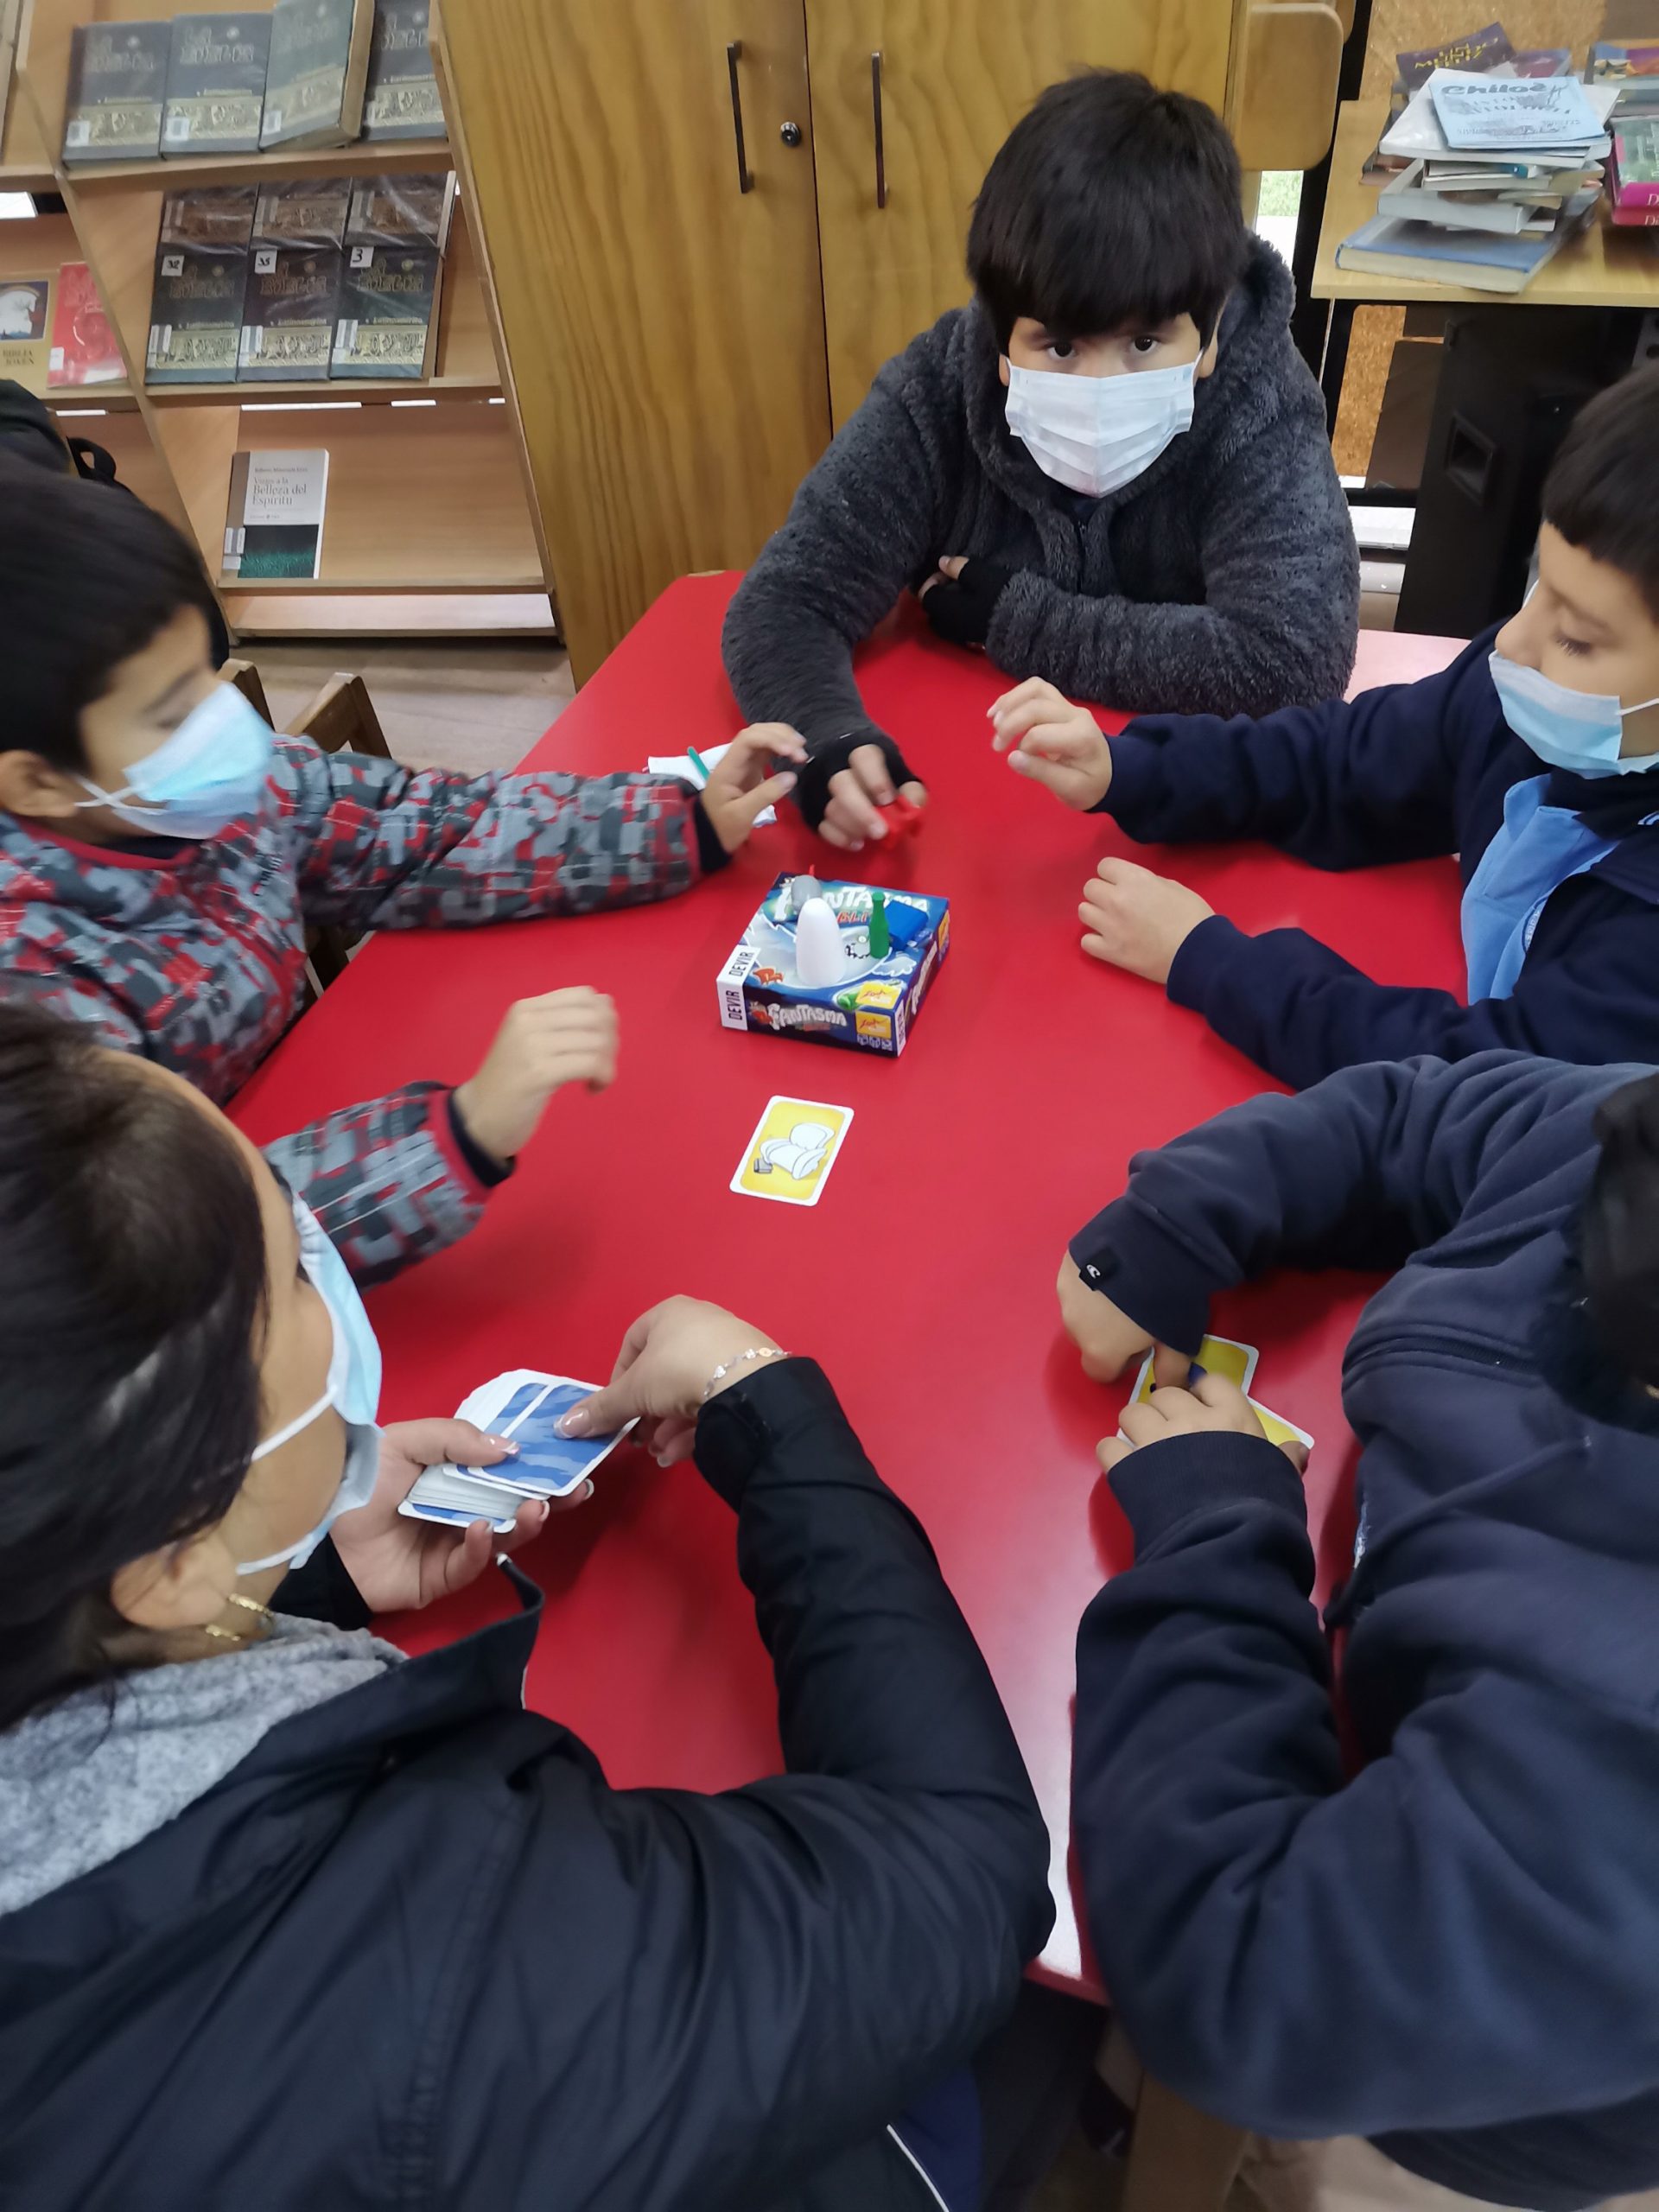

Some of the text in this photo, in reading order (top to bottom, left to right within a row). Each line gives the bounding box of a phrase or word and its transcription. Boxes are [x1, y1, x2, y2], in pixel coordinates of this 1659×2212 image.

[253, 483, 308, 495] Belleza del
[728, 950, 755, 977] DEVIR
[725, 989, 743, 1021] DEVIR
[766, 1002, 848, 1031] FANTASMA
